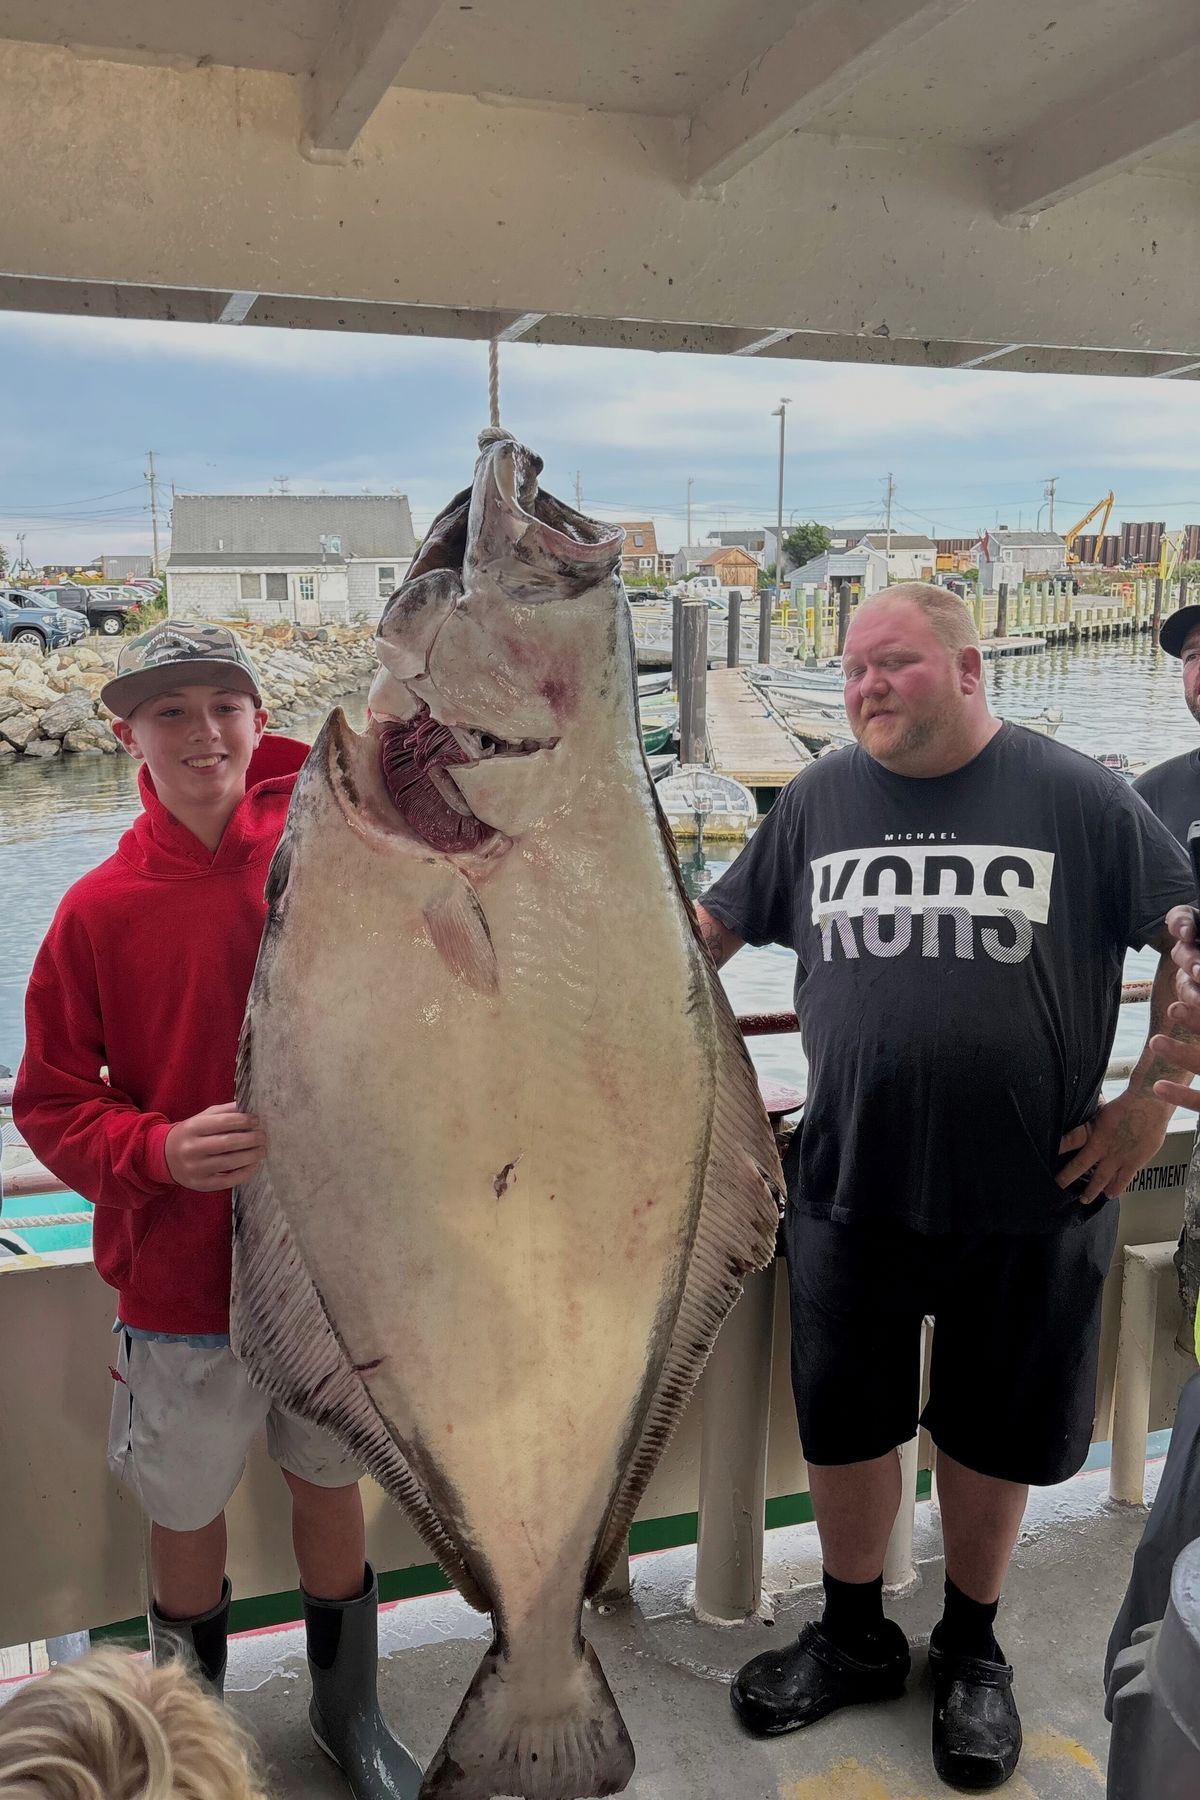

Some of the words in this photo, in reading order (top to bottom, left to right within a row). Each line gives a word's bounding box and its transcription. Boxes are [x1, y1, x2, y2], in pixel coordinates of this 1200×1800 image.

[885, 832, 958, 841] MICHAEL
[819, 855, 1035, 964] KORS
[1126, 1164, 1188, 1193] PARTMENT
